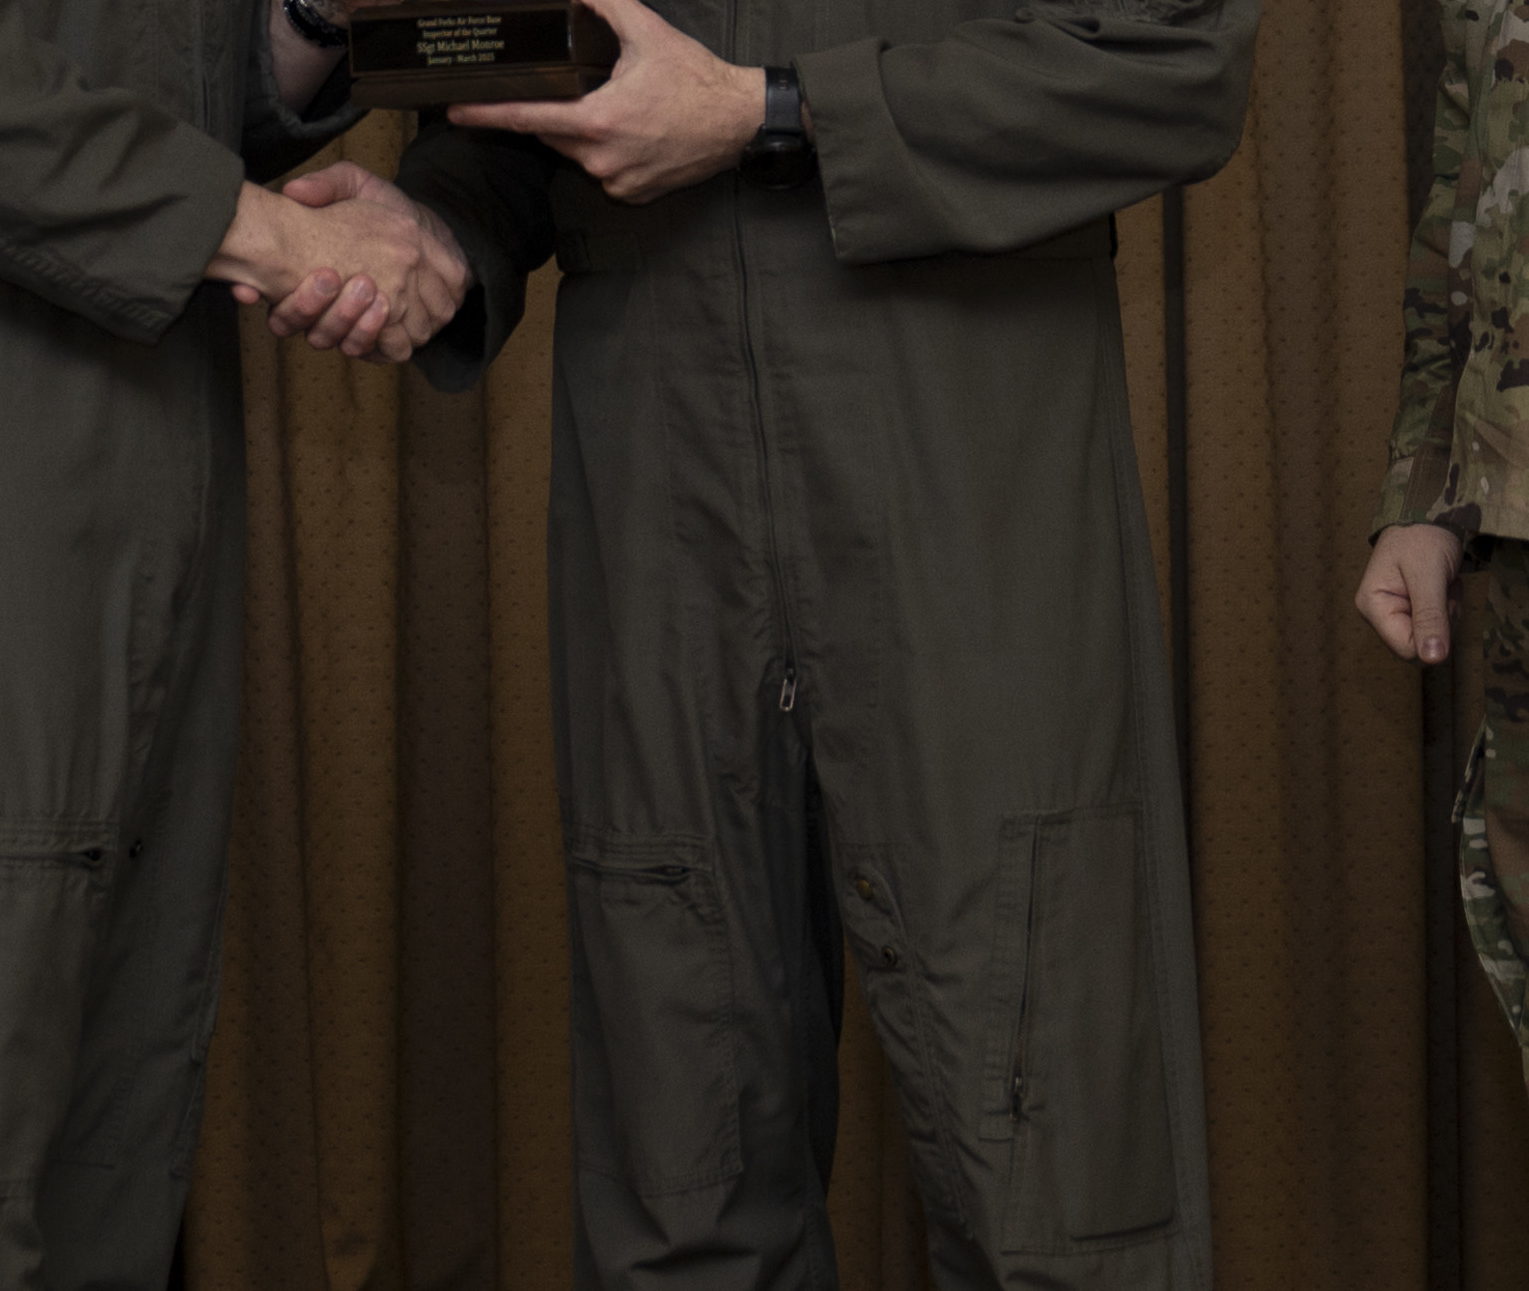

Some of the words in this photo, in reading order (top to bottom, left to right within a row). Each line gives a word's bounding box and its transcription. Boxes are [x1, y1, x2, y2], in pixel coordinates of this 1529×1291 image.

[461, 28, 471, 37] the
[437, 39, 471, 52] Michael
[471, 39, 505, 50] Monroe
